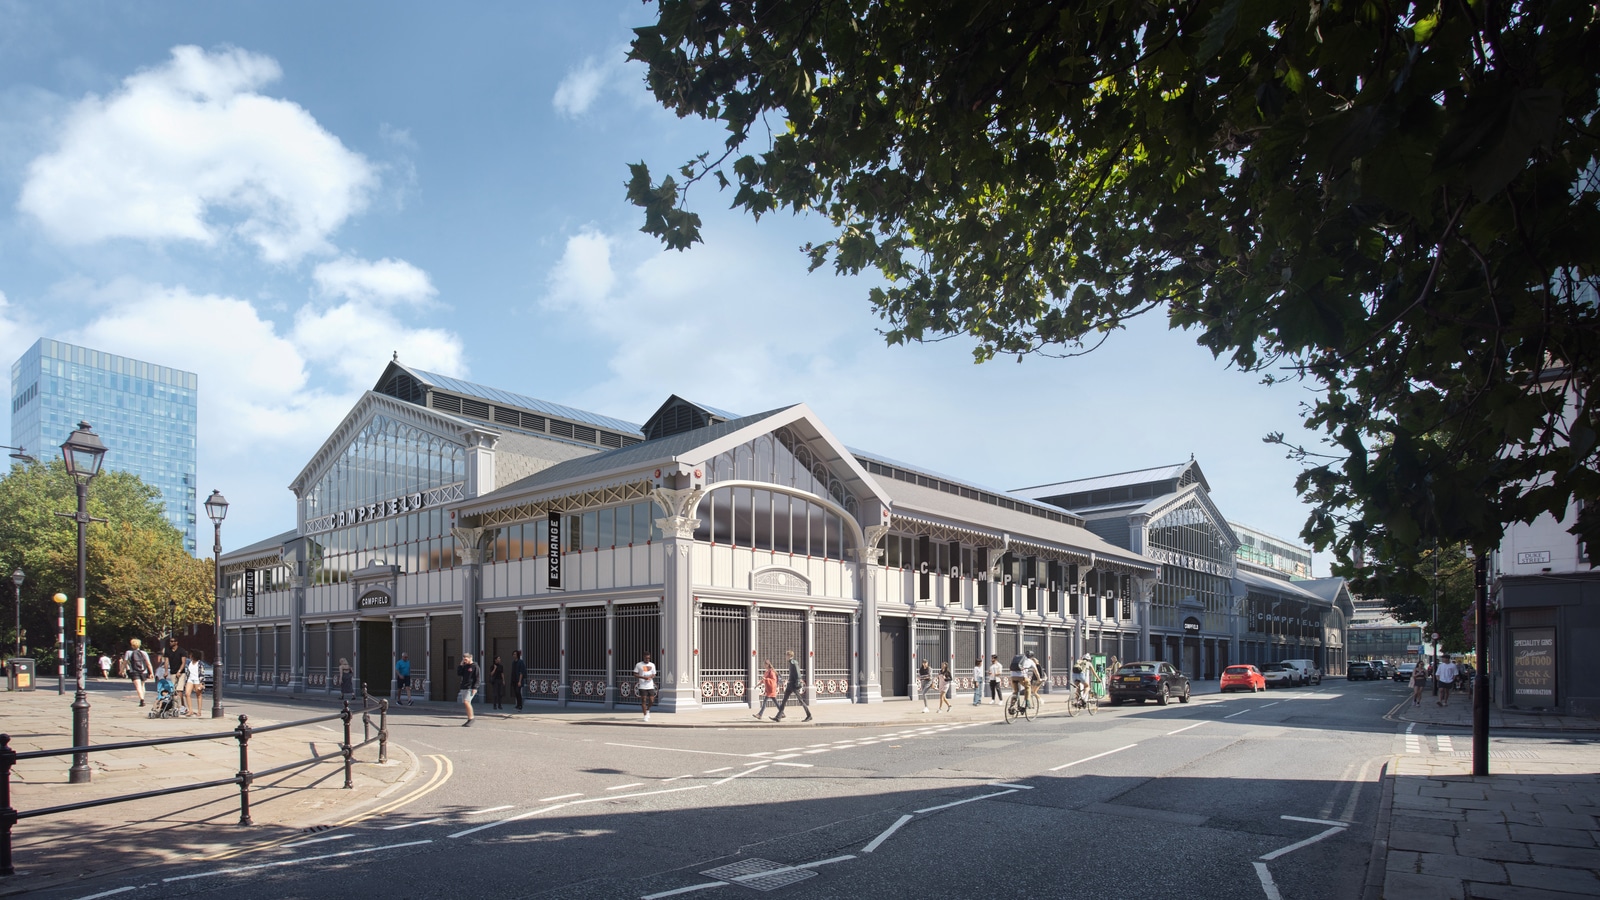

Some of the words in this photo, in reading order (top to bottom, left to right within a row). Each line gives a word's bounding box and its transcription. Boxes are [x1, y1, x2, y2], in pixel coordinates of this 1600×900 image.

[330, 493, 423, 529] CAMPFIELD
[550, 520, 559, 579] EXCHANGE
[362, 596, 388, 606] CAMPFIELD
[1257, 612, 1320, 628] CAMPFIELD
[1515, 656, 1530, 666] PUB
[1531, 656, 1552, 666] FOOD
[1515, 670, 1541, 678] CASK
[1543, 671, 1551, 679] &
[1518, 677, 1547, 685] CRAFT
